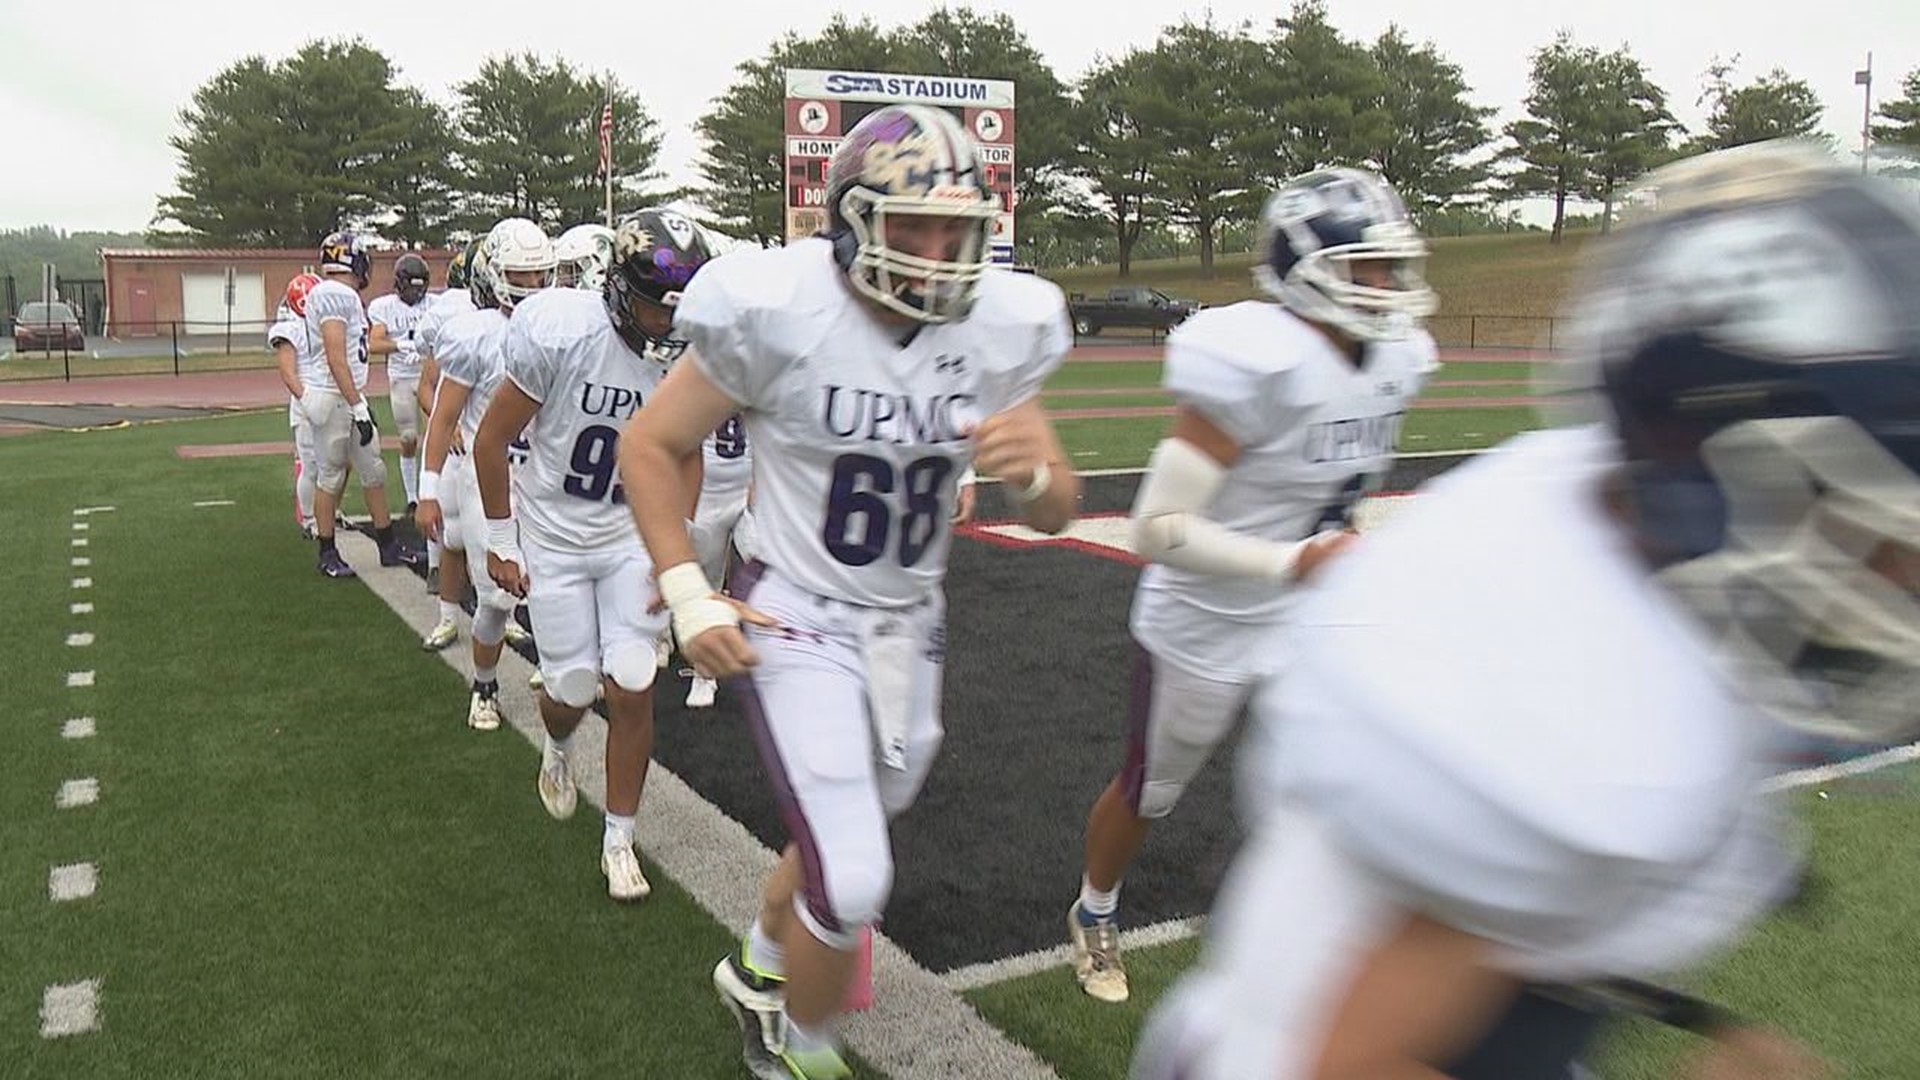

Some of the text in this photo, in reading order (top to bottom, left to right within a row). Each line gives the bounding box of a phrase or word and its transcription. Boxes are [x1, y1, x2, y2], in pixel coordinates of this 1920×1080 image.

[887, 78, 987, 100] STADIUM
[798, 141, 840, 155] HOM
[982, 148, 1011, 161] TOR
[823, 384, 976, 445] UPMC
[562, 423, 626, 505] 9
[823, 452, 955, 569] 68
